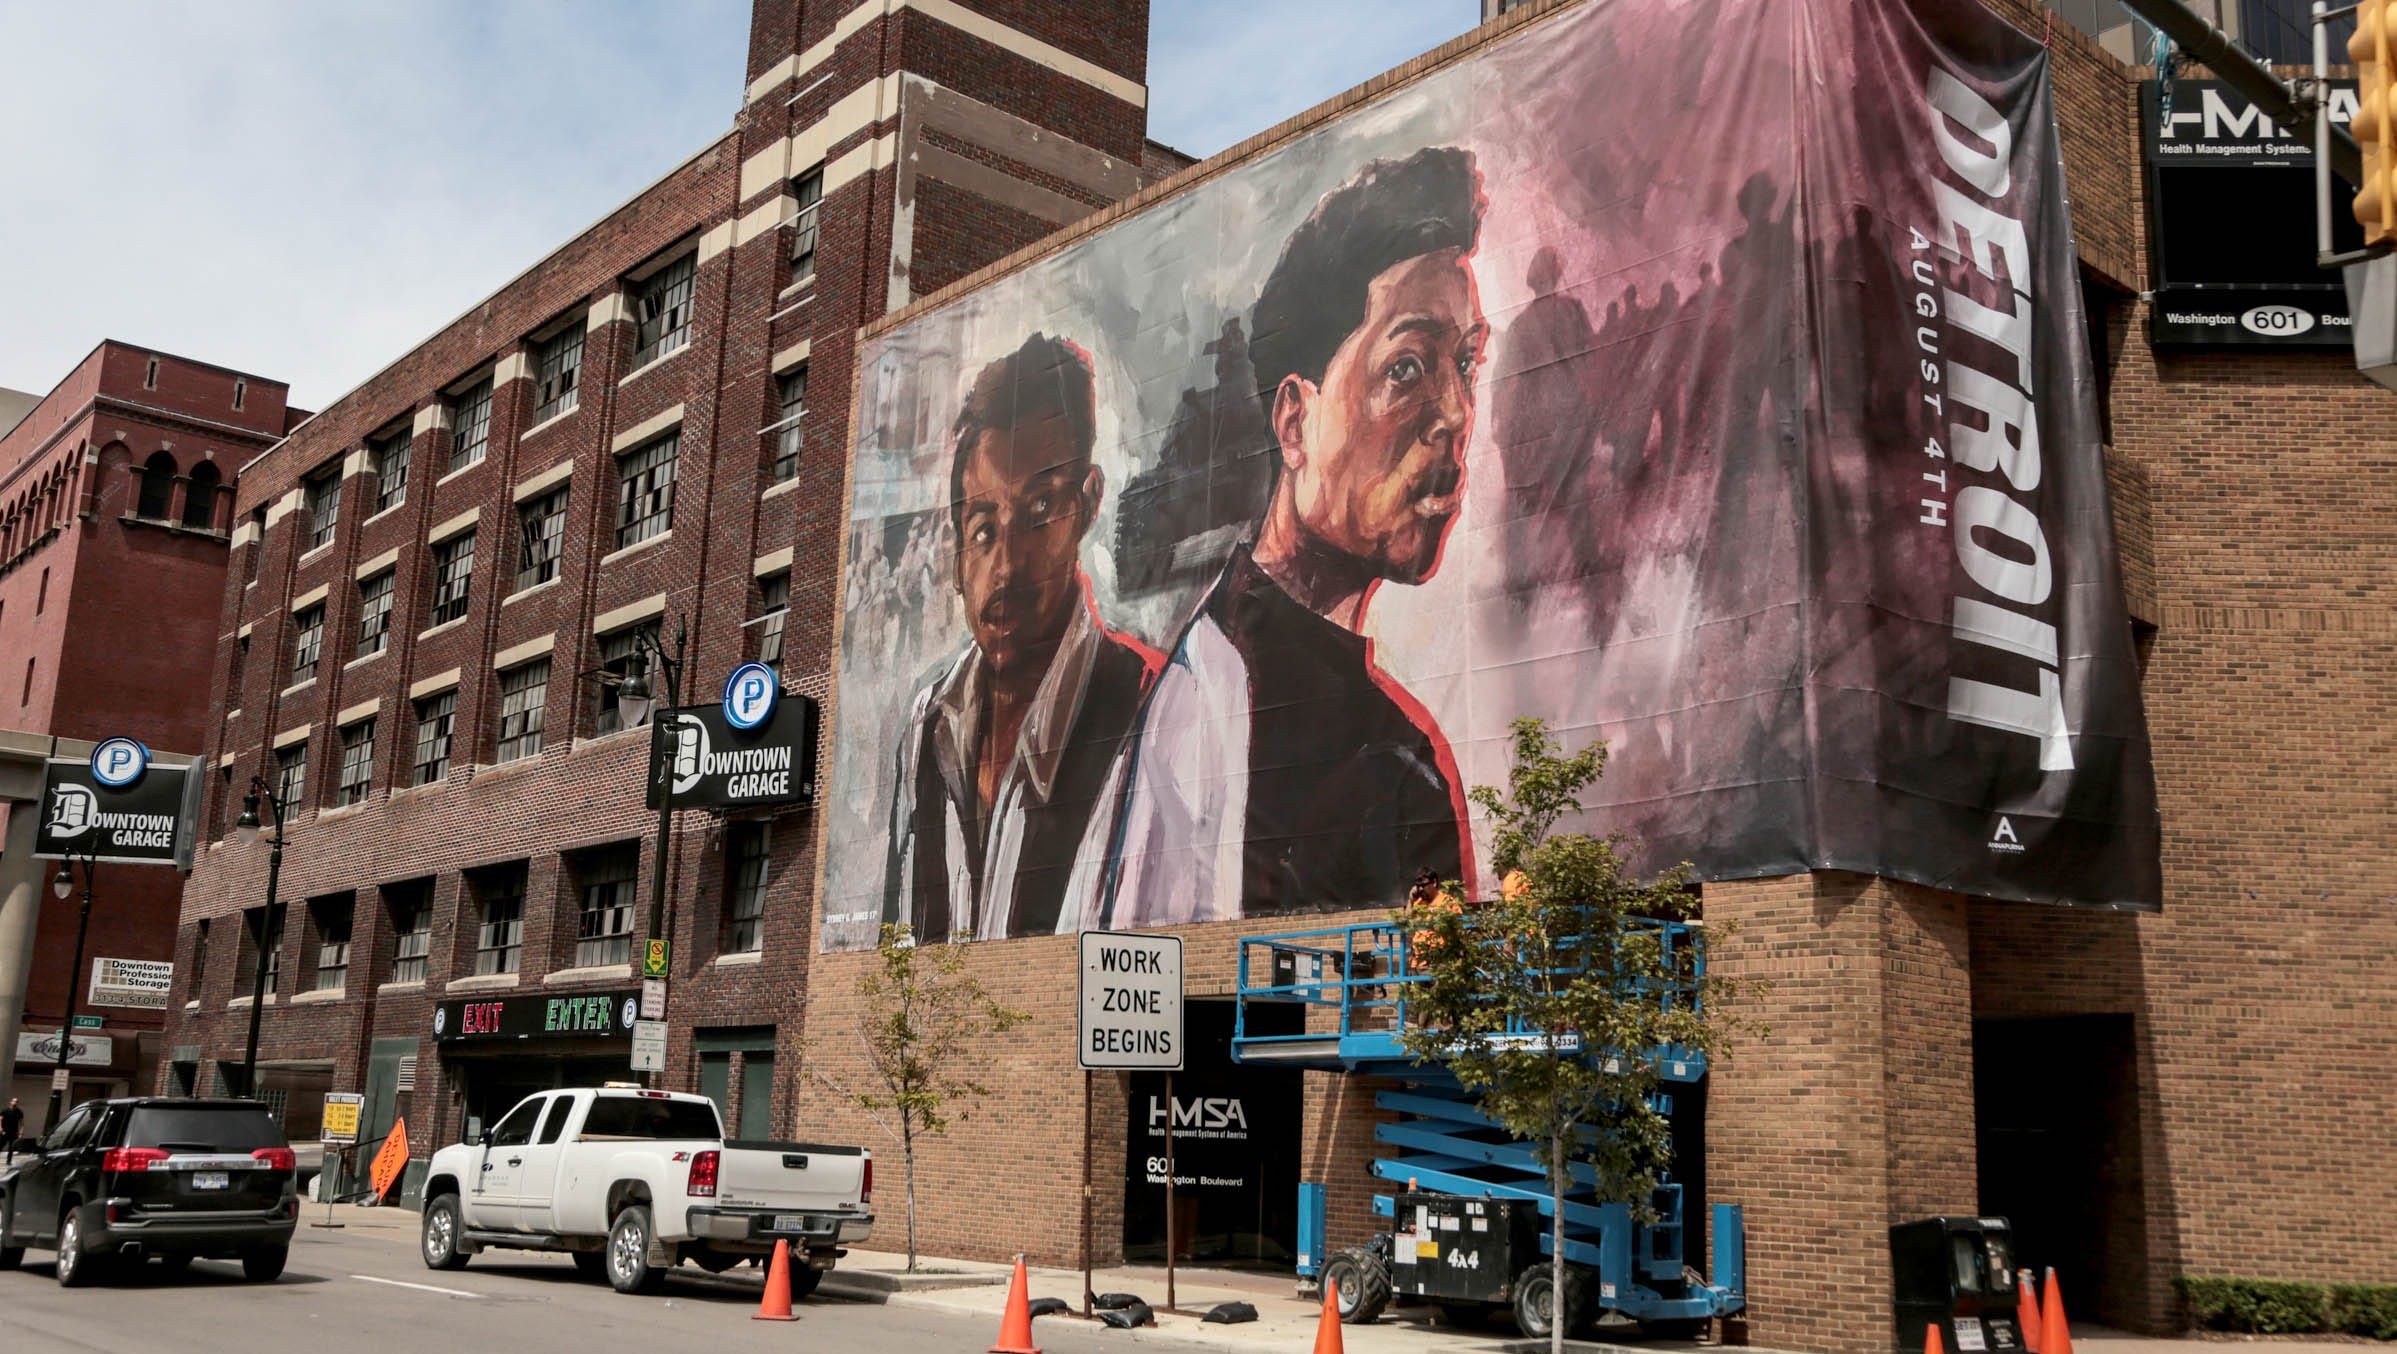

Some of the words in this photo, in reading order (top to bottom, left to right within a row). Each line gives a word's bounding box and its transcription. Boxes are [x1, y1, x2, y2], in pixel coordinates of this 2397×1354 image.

[2160, 89, 2361, 137] HMA
[2159, 144, 2192, 154] Health
[2196, 144, 2262, 156] Management
[1909, 225, 1942, 415] AUGUST
[2166, 312, 2236, 326] Washington
[2253, 311, 2298, 329] 601
[1926, 64, 2075, 771] DETROIT
[1920, 436, 1947, 527] 4TH
[744, 678, 764, 714] P
[107, 747, 131, 774] P
[728, 771, 790, 798] GARAGE
[112, 829, 172, 848] GARAGE
[112, 960, 170, 972] Downtown
[1100, 947, 1162, 975] WORK
[127, 978, 170, 989] Storage
[545, 996, 612, 1031] ENTER
[1102, 988, 1161, 1014] ZONE
[462, 1002, 504, 1033] EXIT
[1092, 1028, 1172, 1054] BEGINS
[1149, 1095, 1247, 1129] HMSA
[1149, 1127, 1165, 1136] Health
[1199, 1129, 1219, 1139] Systems
[1227, 1130, 1247, 1139] America
[1146, 1173, 1196, 1186] Washngton
[1200, 1175, 1243, 1187] Boulevard
[1447, 1247, 1479, 1269] 4x4
